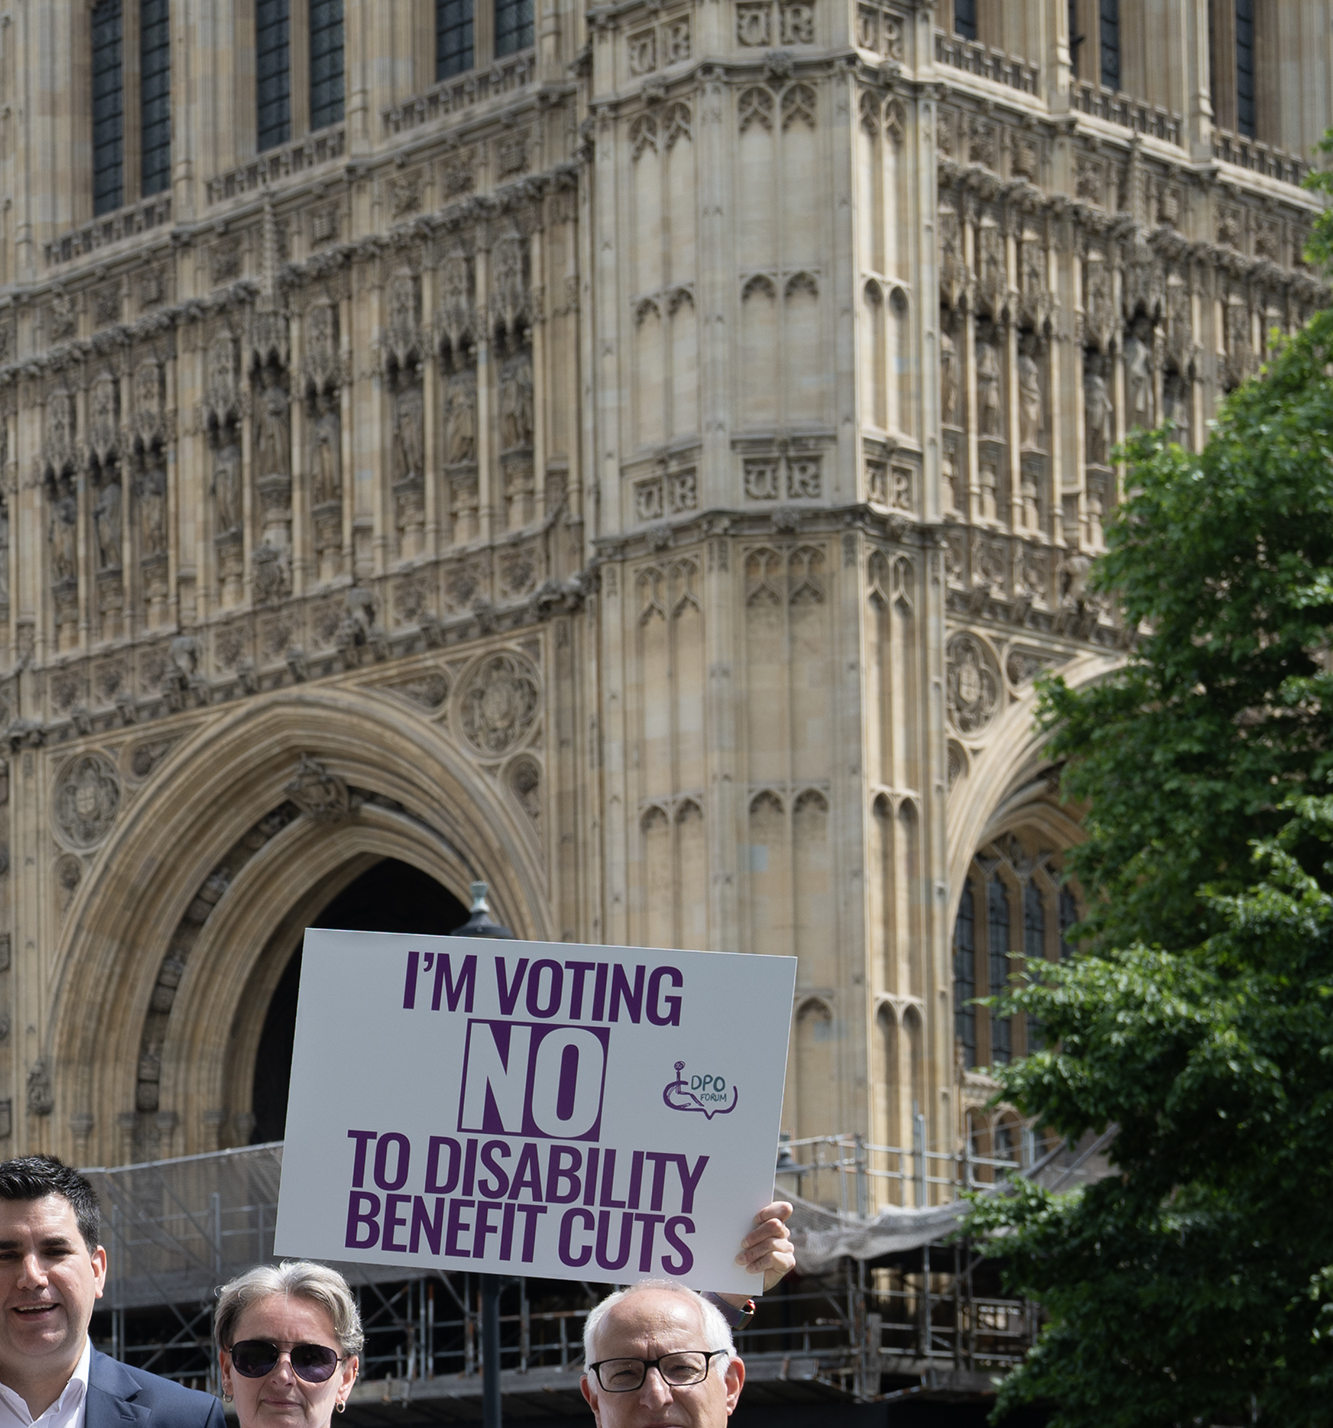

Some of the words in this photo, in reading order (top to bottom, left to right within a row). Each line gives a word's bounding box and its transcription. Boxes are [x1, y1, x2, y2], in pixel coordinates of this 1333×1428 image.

[403, 951, 477, 1013] I'M
[495, 956, 683, 1026] VOTING
[461, 1024, 604, 1137] NO
[691, 1075, 726, 1092] DPO
[700, 1093, 727, 1102] FORUM
[347, 1130, 411, 1191] TO
[424, 1135, 709, 1214] DISABILITY
[345, 1191, 547, 1263] BENEFIT
[558, 1208, 695, 1276] CUTS
